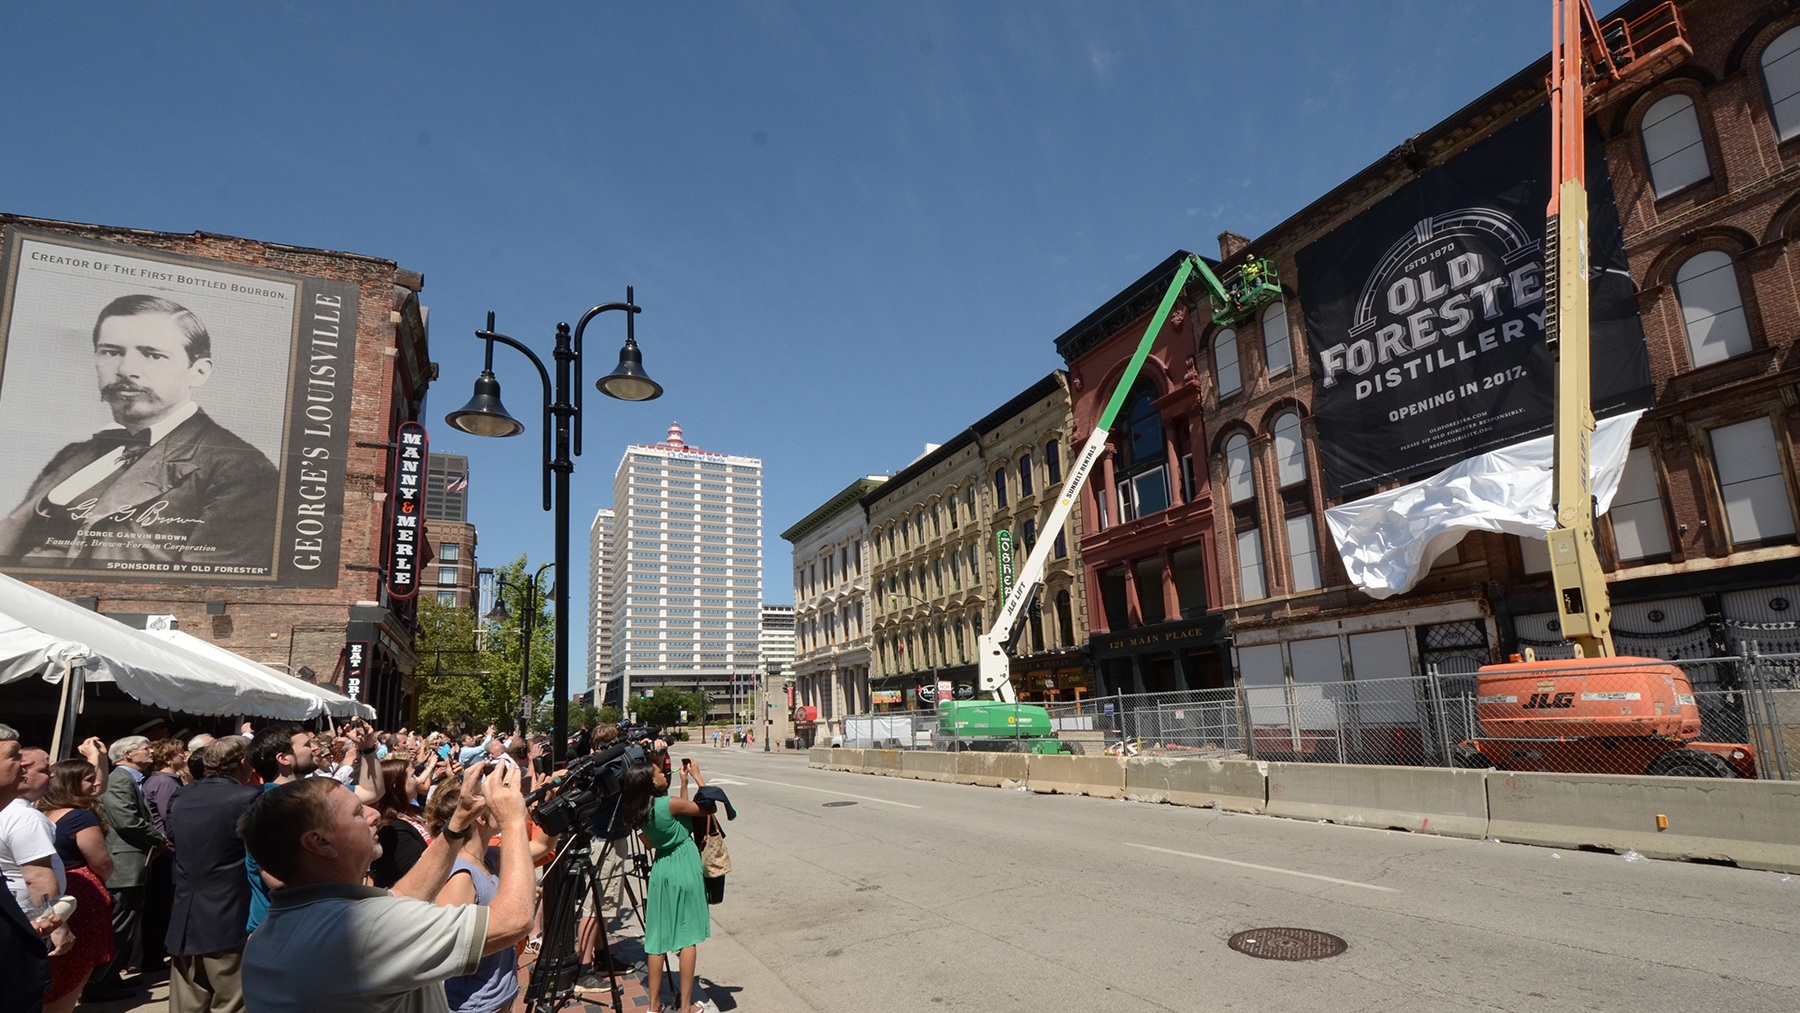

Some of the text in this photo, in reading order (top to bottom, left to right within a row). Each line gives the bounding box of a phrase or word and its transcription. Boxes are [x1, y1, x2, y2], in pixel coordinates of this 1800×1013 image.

[1430, 243, 1455, 260] 1870
[31, 251, 288, 300] CREATOR OF THE FIRST BOTTLED BOURBON.
[1387, 252, 1484, 315] OLD
[1320, 261, 1548, 389] FORESTE
[1356, 308, 1547, 400] DISTILLERY
[1388, 365, 1527, 422] OPENING IN 2017.
[293, 293, 342, 570] GEORGE'S LOUISVILLE
[1400, 407, 1526, 451] PLEASE SIP OLD FORESTER RESPONSIBLY.
[1429, 411, 1488, 434] OLDFORESTER.COM
[1429, 426, 1493, 450] RESPONSIBILITY.ORG
[1066, 445, 1097, 498] SUNBELT RENTALS
[395, 433, 422, 584] MANNY & MERLE
[46, 537, 216, 552] Founder, Brown-Forman Corporation
[77, 530, 114, 538] GEORGE
[117, 532, 152, 540] GARVIN
[107, 562, 170, 571] SPONSORED
[173, 564, 187, 572] BY
[1015, 581, 1026, 600] LIFT
[1109, 628, 1202, 649] 121 MAIN PLACE
[349, 644, 362, 667] EAT
[348, 678, 361, 701] DRI
[1522, 692, 1575, 709] JLG
